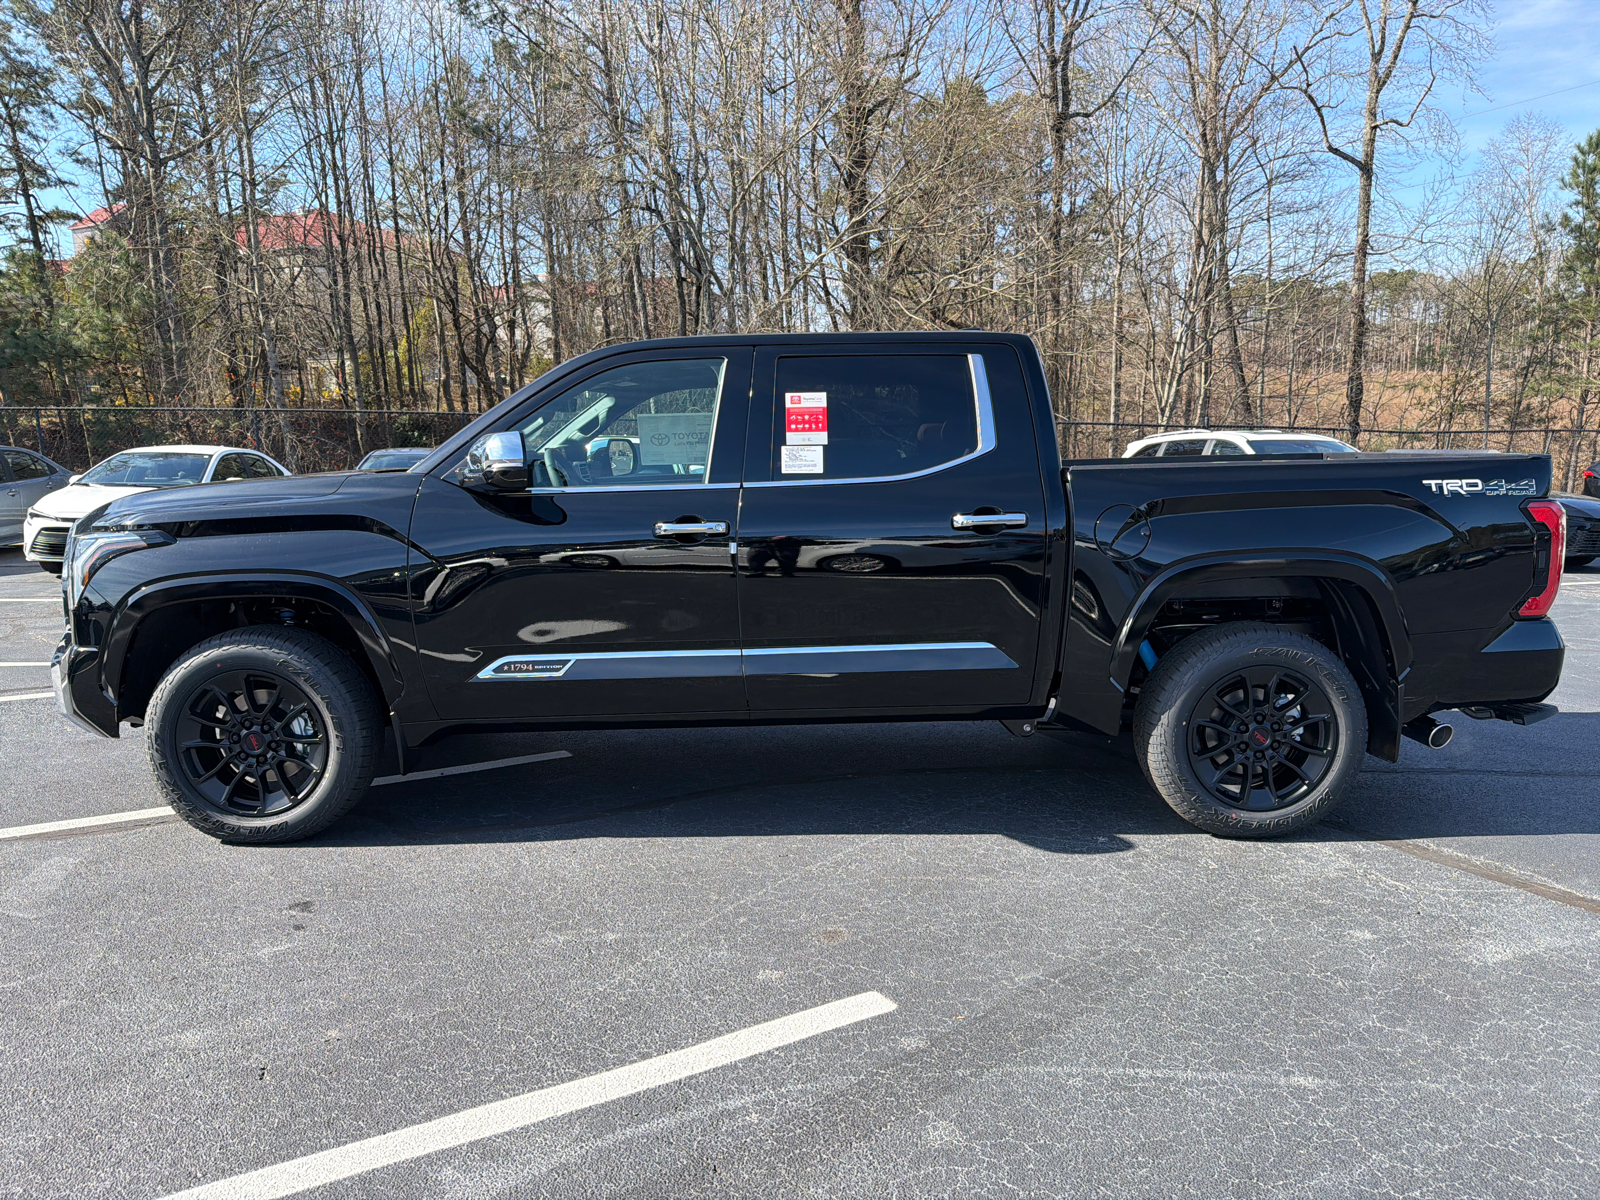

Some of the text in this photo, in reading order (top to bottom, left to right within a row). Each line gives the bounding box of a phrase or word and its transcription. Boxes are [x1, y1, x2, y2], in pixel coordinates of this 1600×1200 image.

[672, 432, 709, 440] TOYOTA
[1422, 479, 1485, 497] TRD
[248, 734, 259, 751] TRD
[1254, 730, 1267, 744] TRD
